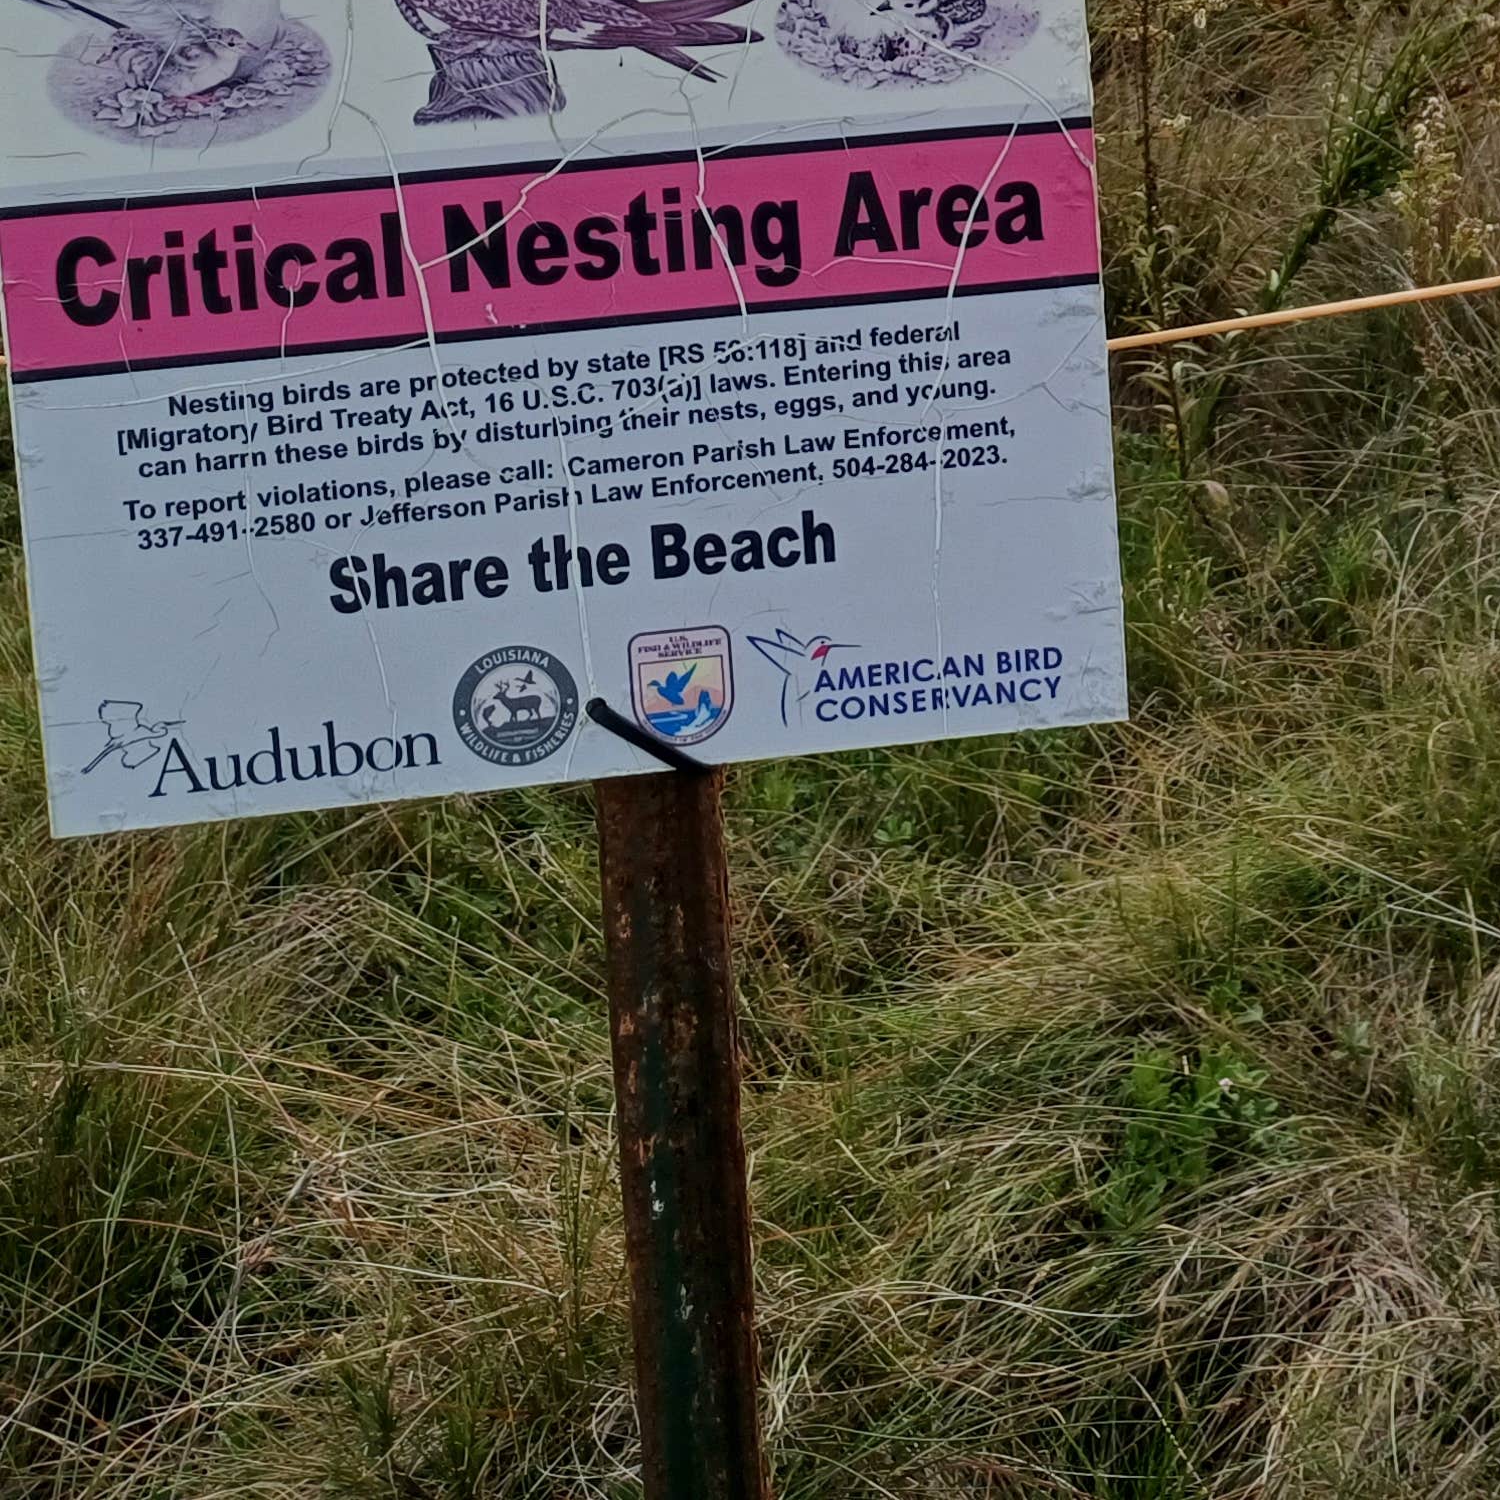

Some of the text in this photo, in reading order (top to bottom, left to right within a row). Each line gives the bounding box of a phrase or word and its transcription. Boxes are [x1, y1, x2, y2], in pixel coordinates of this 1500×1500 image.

[54, 170, 1044, 325] Critical Nesting Area
[117, 423, 257, 455] [Migratory
[268, 412, 322, 436] Bird
[330, 405, 412, 431] Treaty
[421, 396, 476, 420] Act,
[485, 390, 514, 411] 16
[524, 382, 603, 409] U.S.C.
[710, 373, 775, 394] laws.
[784, 358, 891, 387] Entering
[958, 349, 1011, 370] area
[169, 389, 274, 416] Nesting
[283, 379, 351, 406] birds
[360, 376, 401, 396] are
[410, 359, 538, 396] protected
[548, 358, 578, 382] by
[588, 351, 650, 374] state
[659, 342, 704, 371] [RS
[815, 331, 861, 354] and
[870, 321, 960, 346] federal
[124, 417, 1015, 521] To report violations, please call: Cameron Parish Law Enforcement,
[138, 377, 996, 478] can harm these birds by disturbing their nests, eggs, and young.
[138, 517, 315, 550] 337-491-2580
[325, 513, 351, 530] or
[360, 500, 485, 527] Jefferson
[495, 487, 582, 514] Parish
[592, 482, 643, 504] Law
[832, 445, 1008, 479] 504-284-2023.
[329, 510, 835, 614] Share the Beach
[475, 649, 549, 674] LOUISIANA
[815, 647, 1063, 693] AMERICAN BIRD
[815, 676, 1062, 722] CONSERVANCY
[149, 721, 442, 798] Audubon
[459, 721, 509, 763] WILDLIFE
[525, 711, 575, 762] FISHERIES
